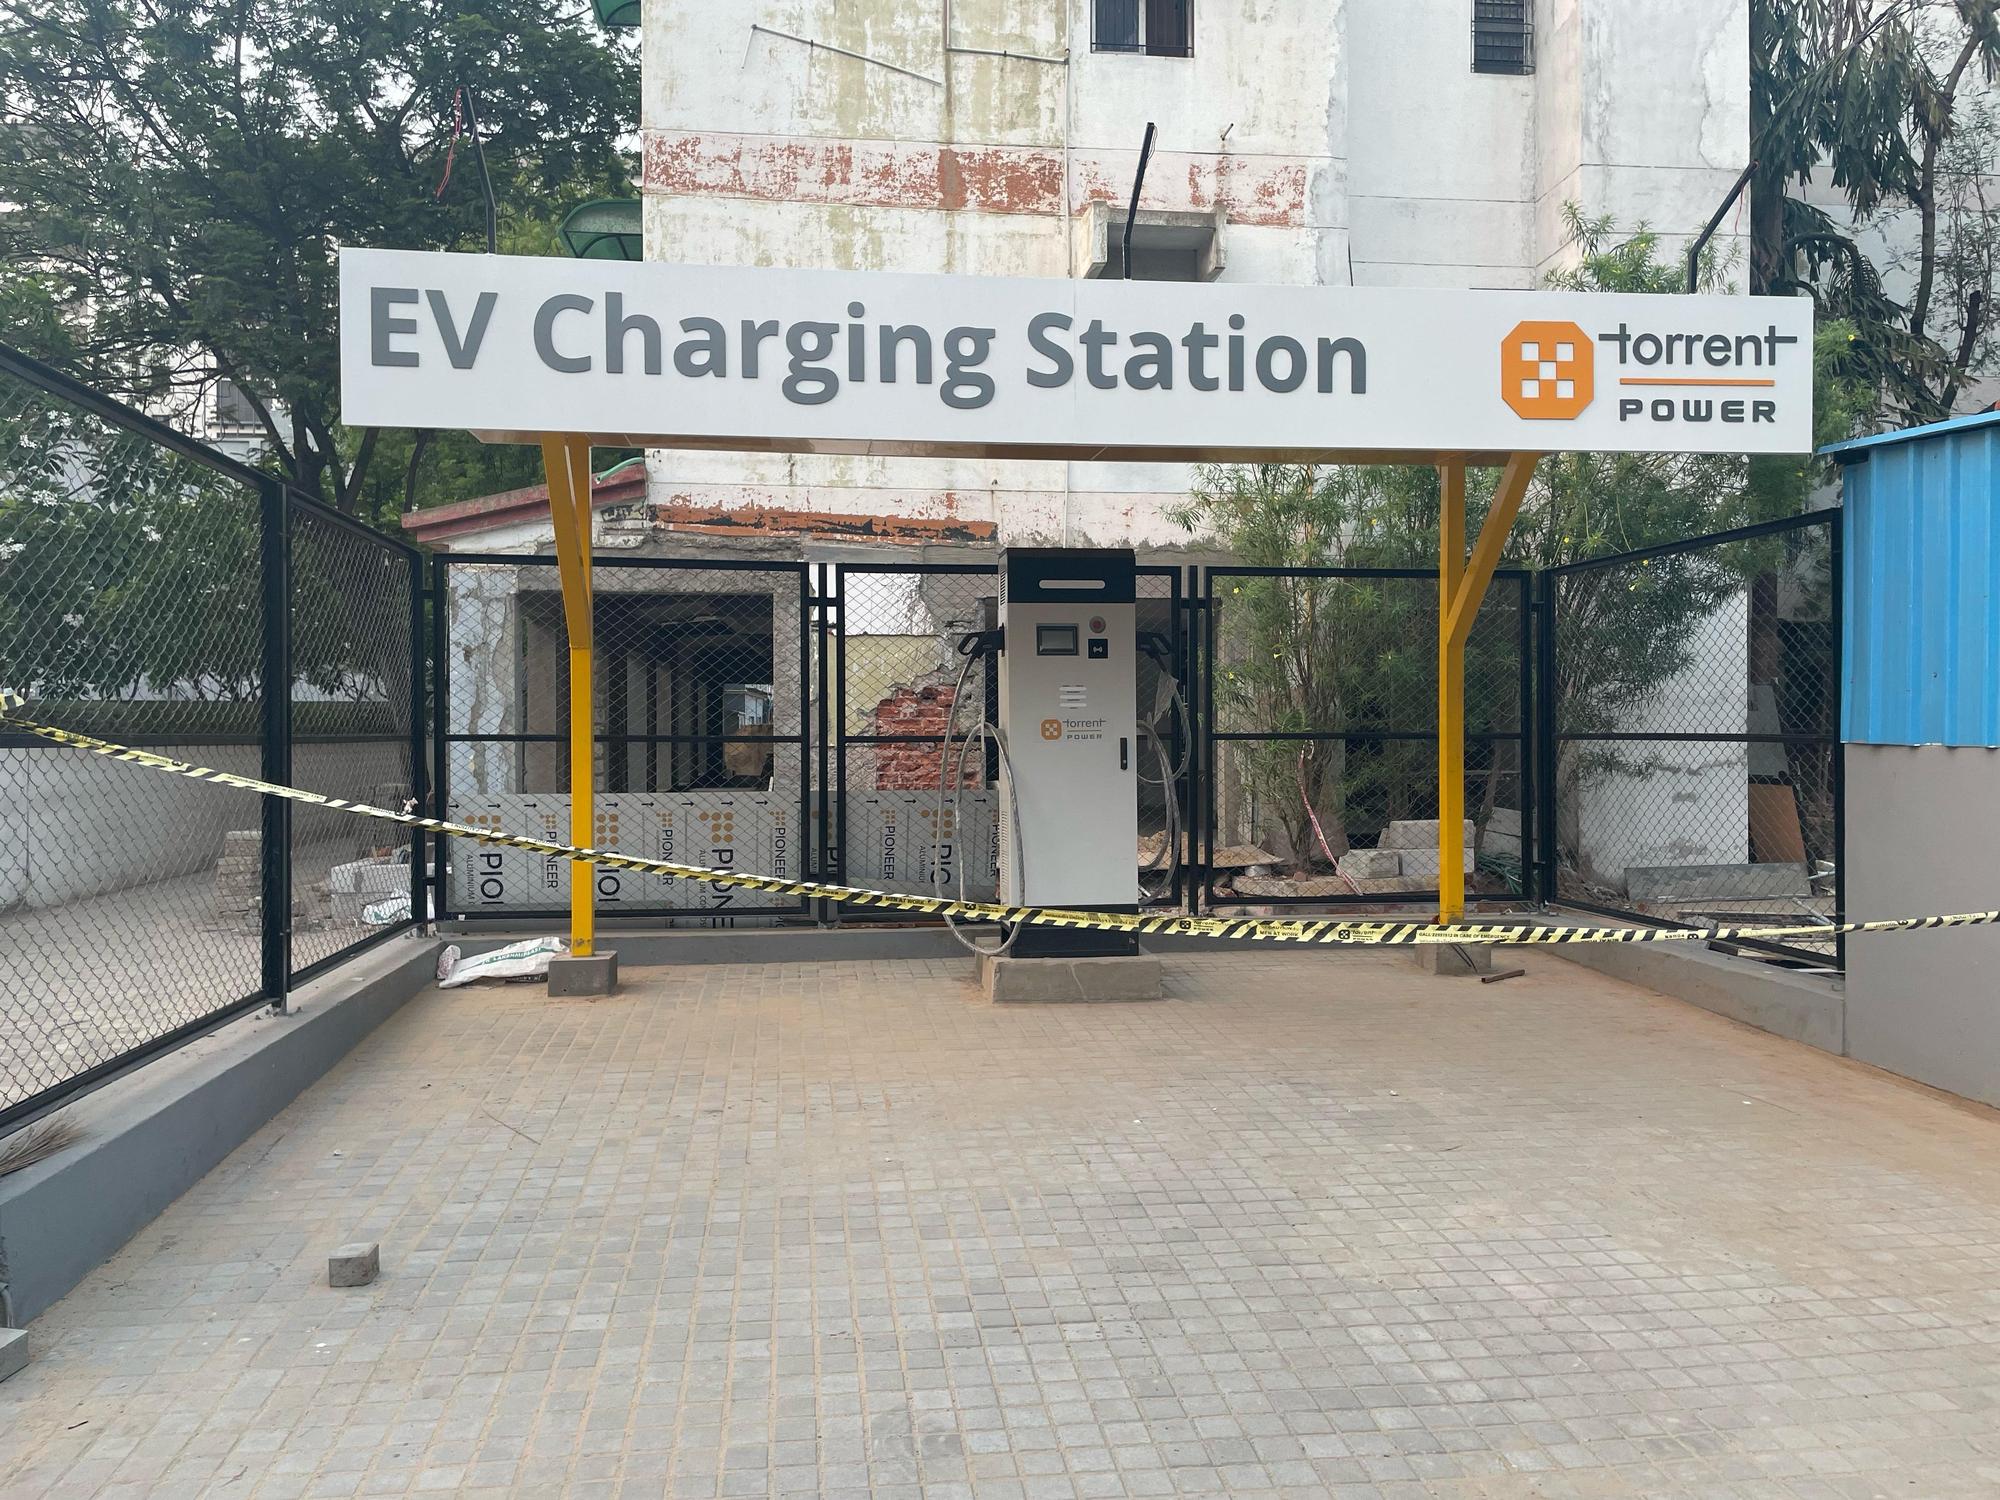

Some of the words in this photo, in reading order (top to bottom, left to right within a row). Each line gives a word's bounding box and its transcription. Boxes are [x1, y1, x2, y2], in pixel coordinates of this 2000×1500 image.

[371, 286, 498, 369] EV
[532, 291, 996, 410] Charging
[1026, 312, 1367, 395] Station
[1598, 323, 1798, 366] torrent
[1619, 399, 1776, 423] POWER
[1062, 718, 1107, 728] torrent
[545, 830, 558, 889] PINEER
[662, 828, 673, 886] PIONR
[884, 825, 895, 881] PIONEER
